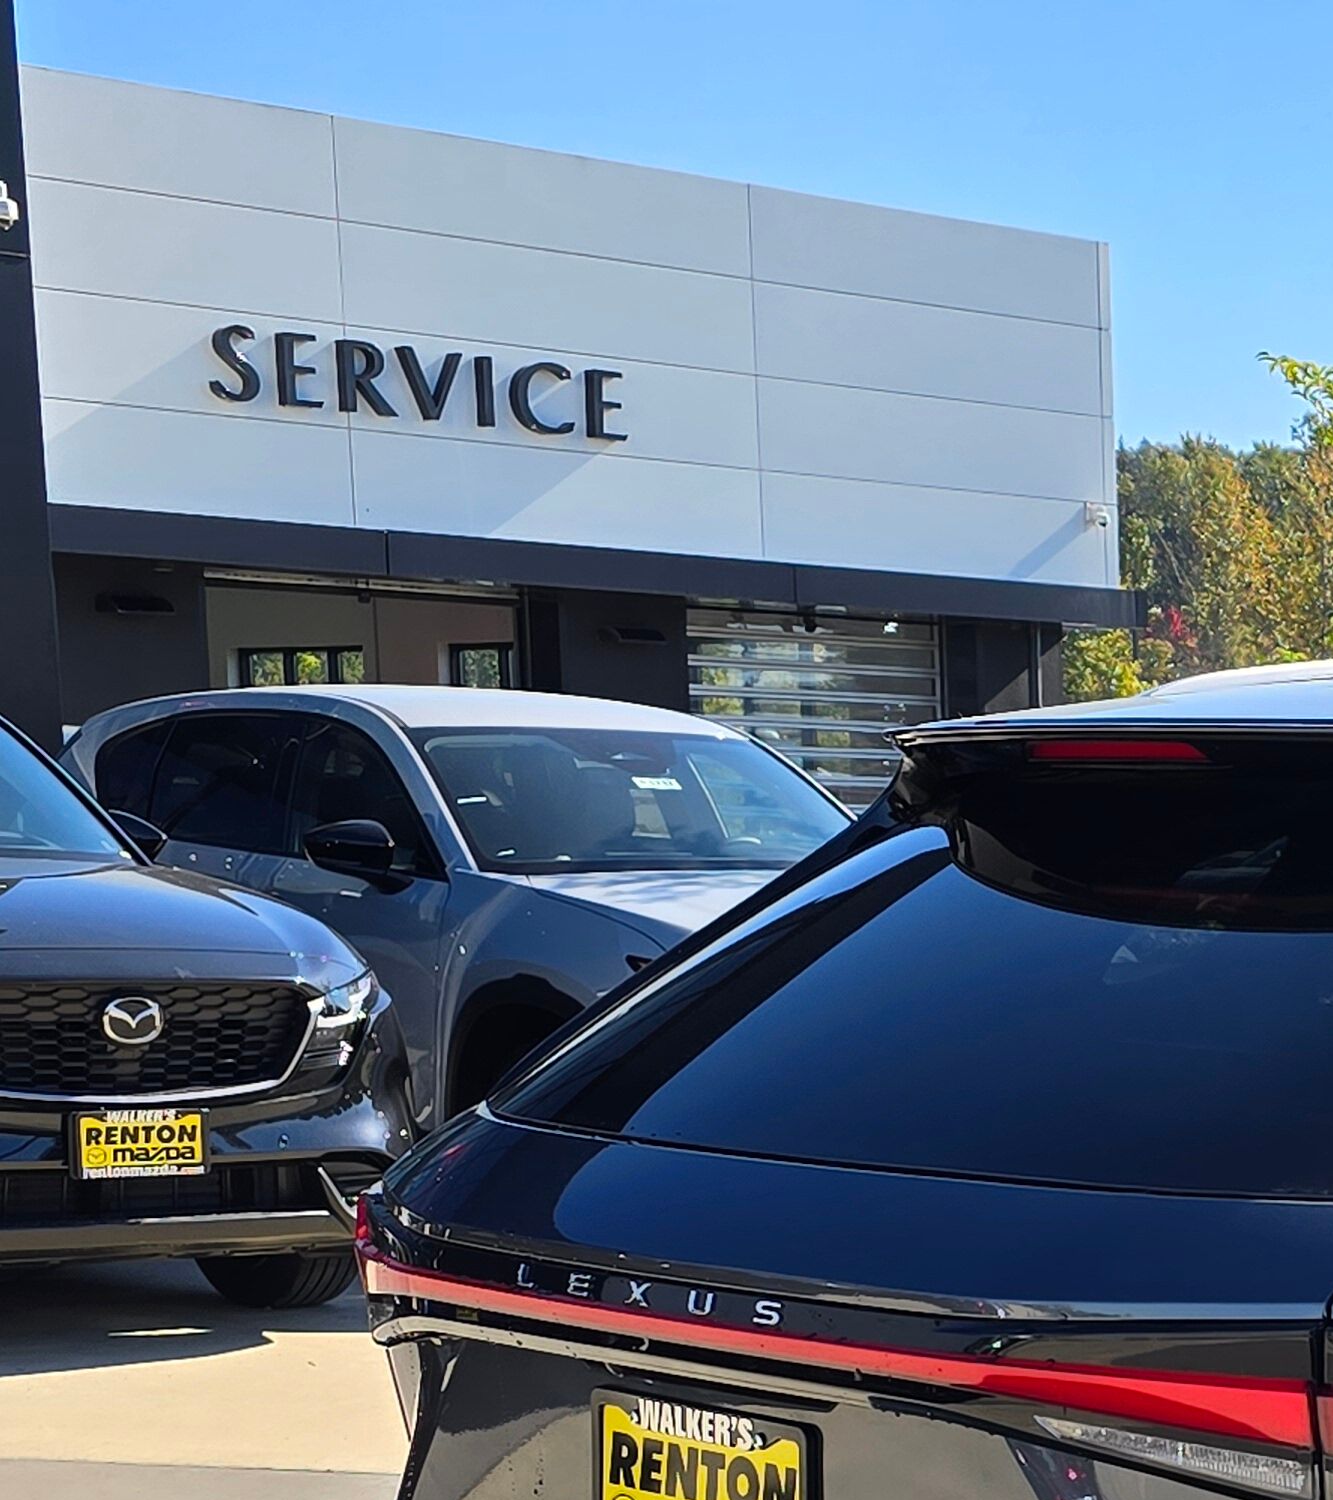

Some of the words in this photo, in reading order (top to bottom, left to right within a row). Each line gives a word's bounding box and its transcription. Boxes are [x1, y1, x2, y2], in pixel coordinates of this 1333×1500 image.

[209, 324, 628, 441] SERVICE
[106, 1109, 176, 1123] WALKER'S
[85, 1125, 197, 1146] RENTON
[113, 1146, 195, 1162] mazda
[516, 1263, 782, 1326] LEXUS
[637, 1399, 753, 1449] WALKER'S
